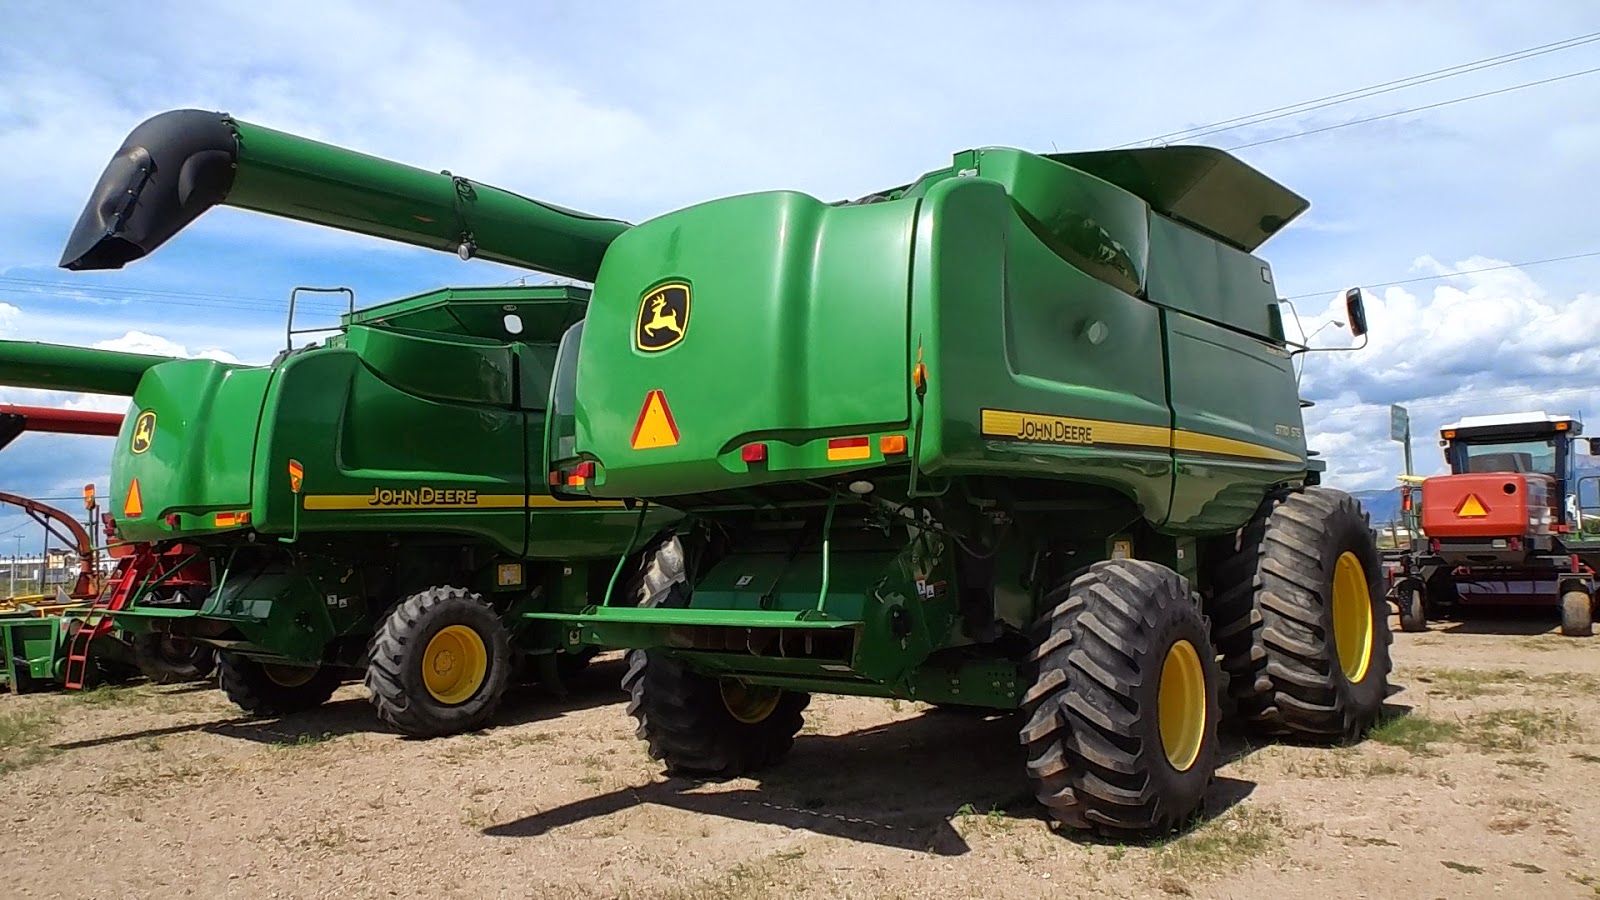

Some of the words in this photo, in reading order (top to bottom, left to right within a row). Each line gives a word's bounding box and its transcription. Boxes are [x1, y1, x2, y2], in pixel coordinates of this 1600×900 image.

[1017, 417, 1053, 439] JOHN
[1055, 420, 1093, 442] DEERE
[369, 486, 419, 505] JOHN
[420, 486, 478, 505] DEERE
